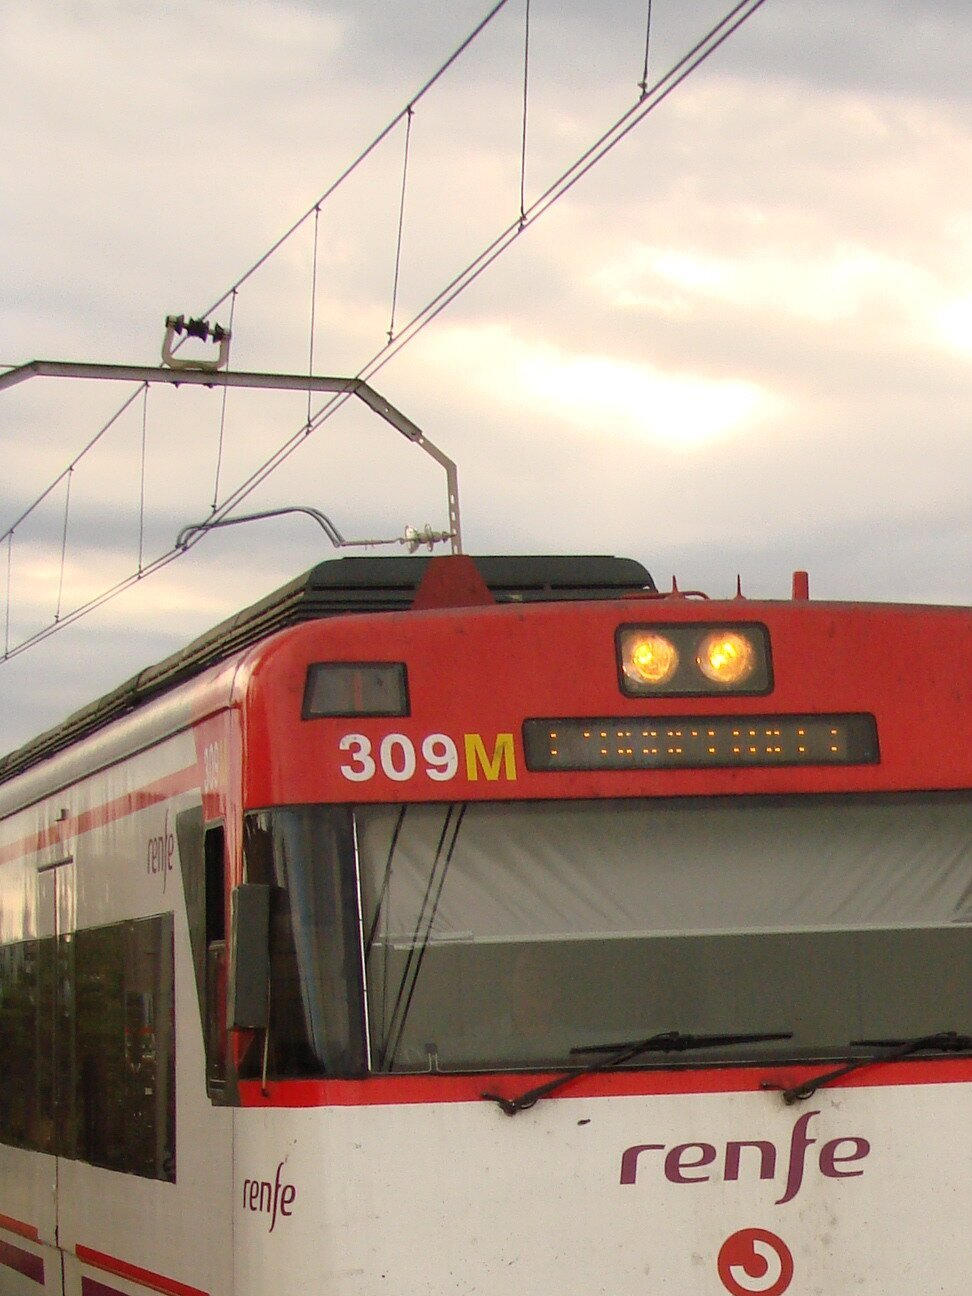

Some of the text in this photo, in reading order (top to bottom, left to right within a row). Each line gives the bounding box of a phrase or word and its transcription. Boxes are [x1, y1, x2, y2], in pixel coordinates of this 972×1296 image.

[339, 733, 516, 782] 309M
[147, 808, 175, 894] renfe
[620, 1110, 870, 1205] renfe
[242, 1162, 296, 1233] renfe
